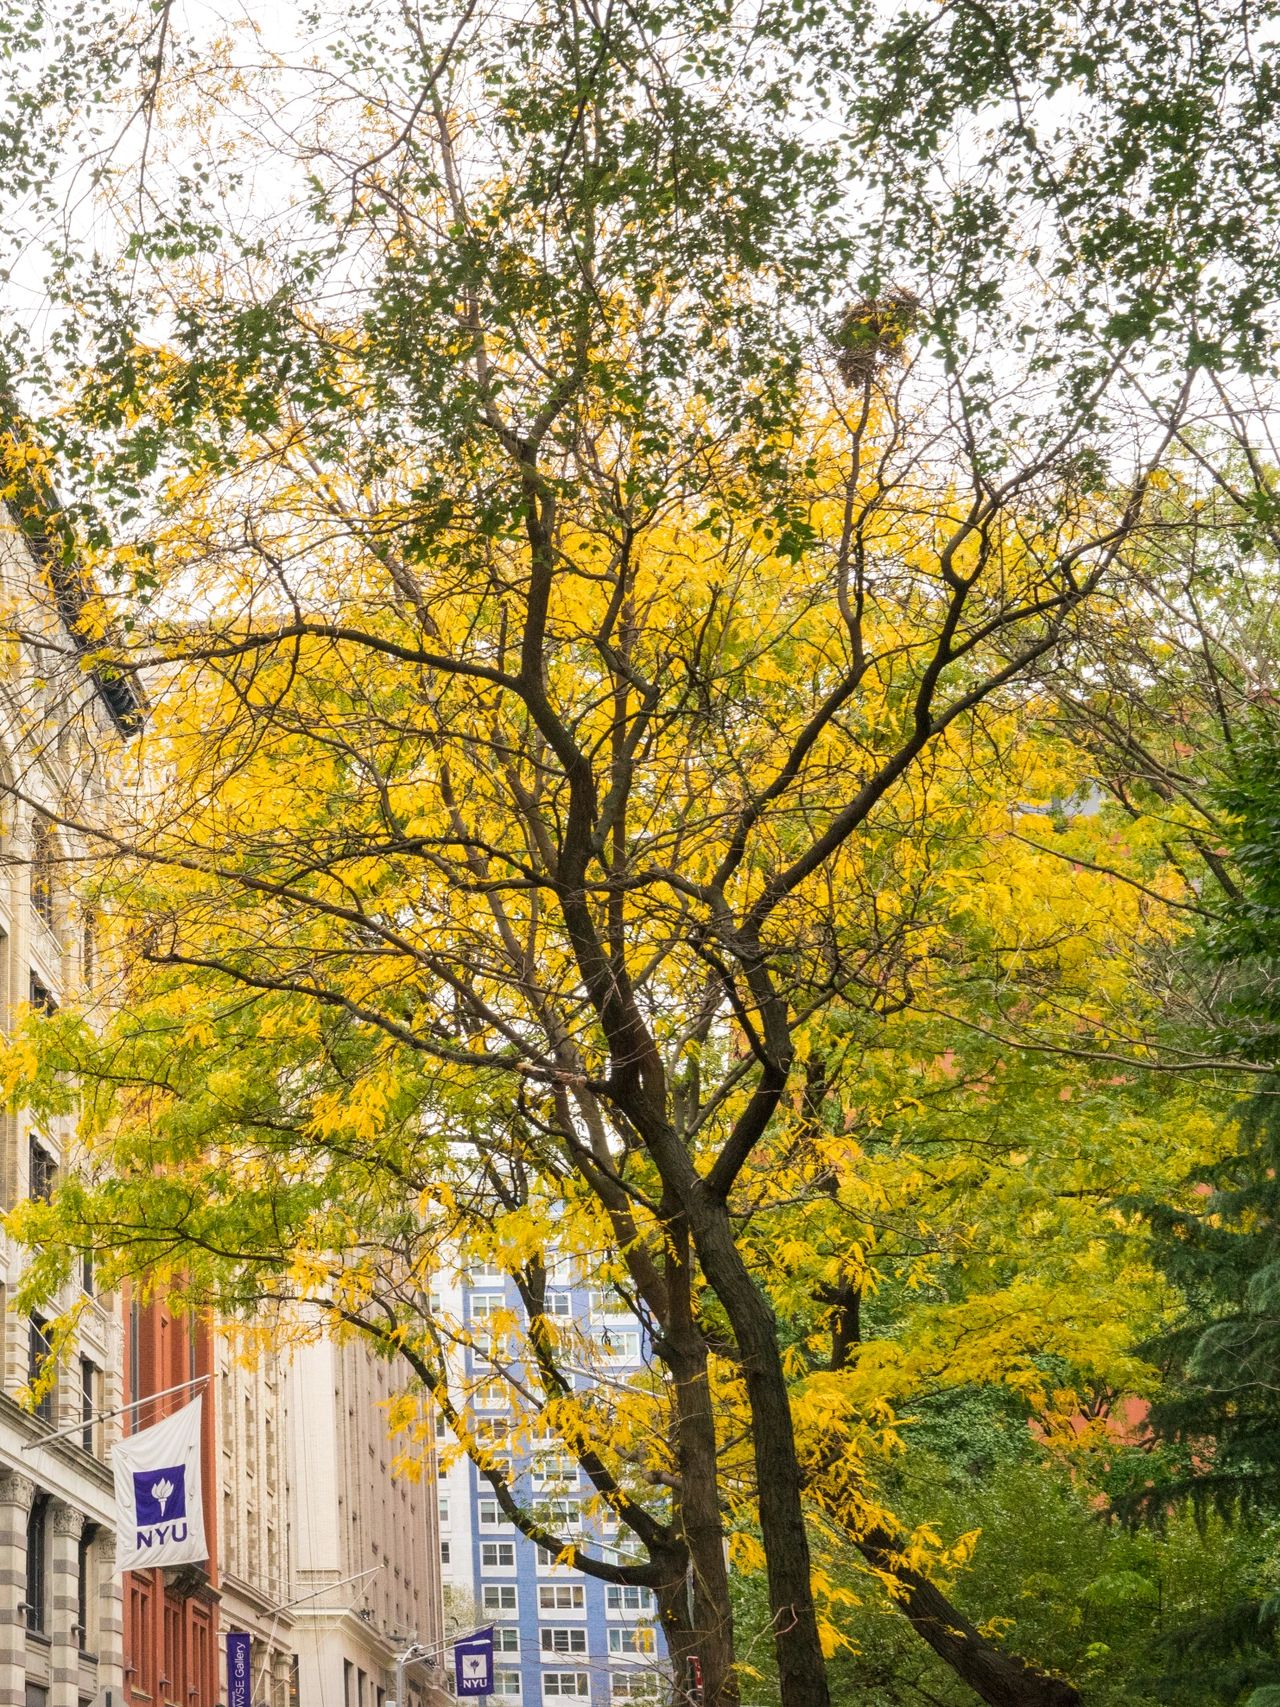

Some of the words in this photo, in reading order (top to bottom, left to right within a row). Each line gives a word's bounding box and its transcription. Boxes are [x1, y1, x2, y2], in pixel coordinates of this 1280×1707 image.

[136, 1522, 188, 1550] NYU
[234, 1641, 246, 1678] Gallery
[235, 1680, 245, 1707] WSE
[463, 1678, 488, 1689] NYU
